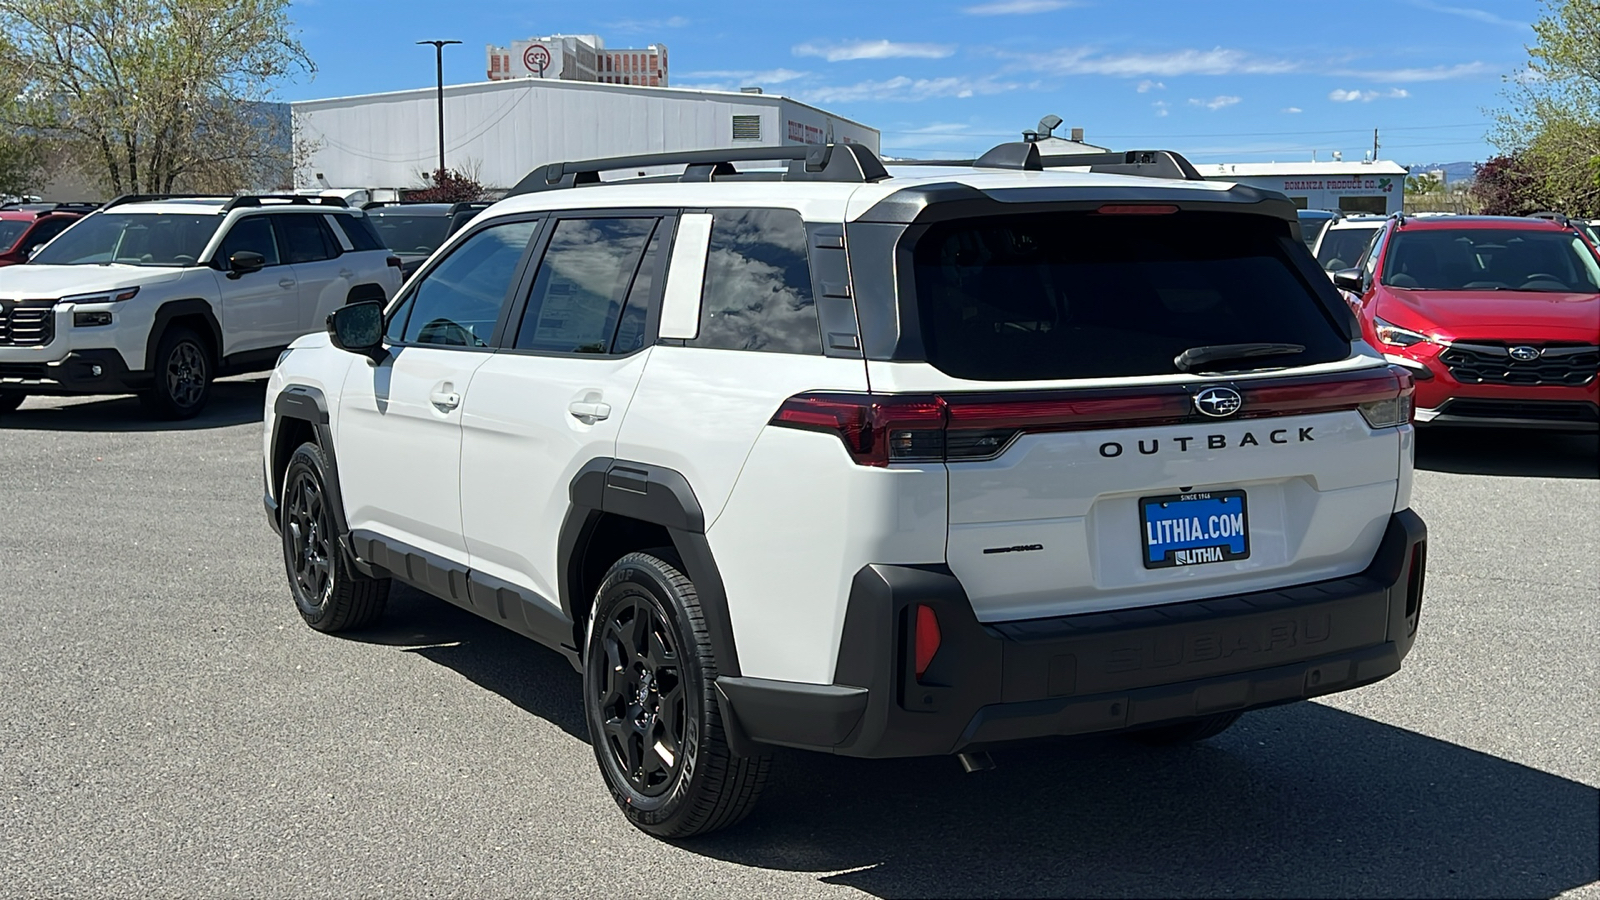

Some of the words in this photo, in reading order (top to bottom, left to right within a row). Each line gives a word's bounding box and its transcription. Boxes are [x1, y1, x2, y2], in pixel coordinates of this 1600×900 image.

[1284, 181, 1324, 190] BONANZA
[1327, 180, 1362, 189] PRODUCE
[1099, 427, 1315, 458] OUTBACK
[1147, 513, 1244, 545] LITHIA.COM
[1186, 547, 1224, 564] LITHIA
[1106, 613, 1332, 674] SUBARU
